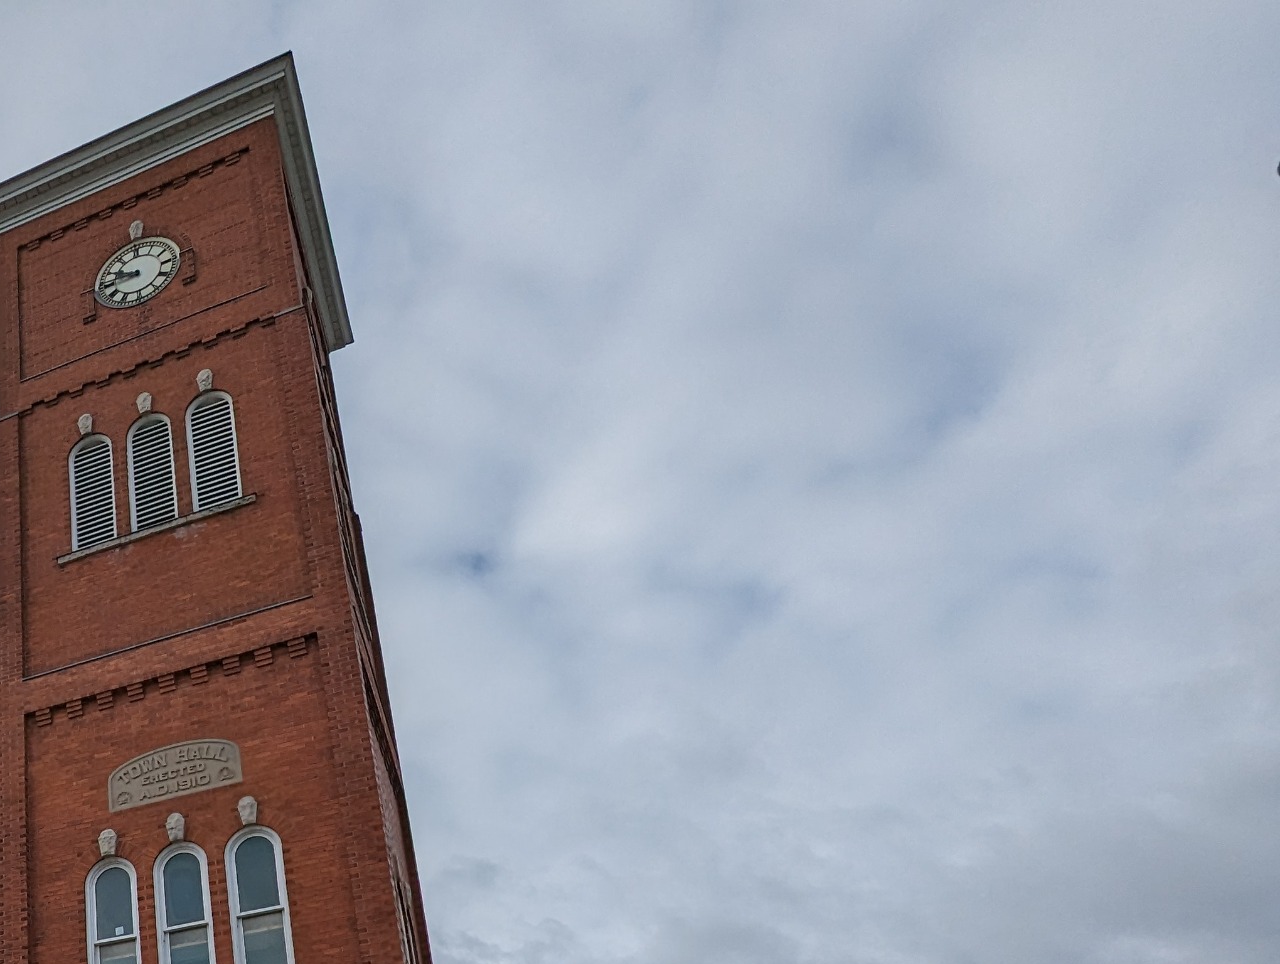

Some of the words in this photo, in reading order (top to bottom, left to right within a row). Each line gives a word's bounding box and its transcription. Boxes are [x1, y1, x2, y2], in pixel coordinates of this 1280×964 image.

[117, 753, 167, 784] TOWN
[175, 744, 228, 763] HALL
[141, 763, 206, 786] ERECTED
